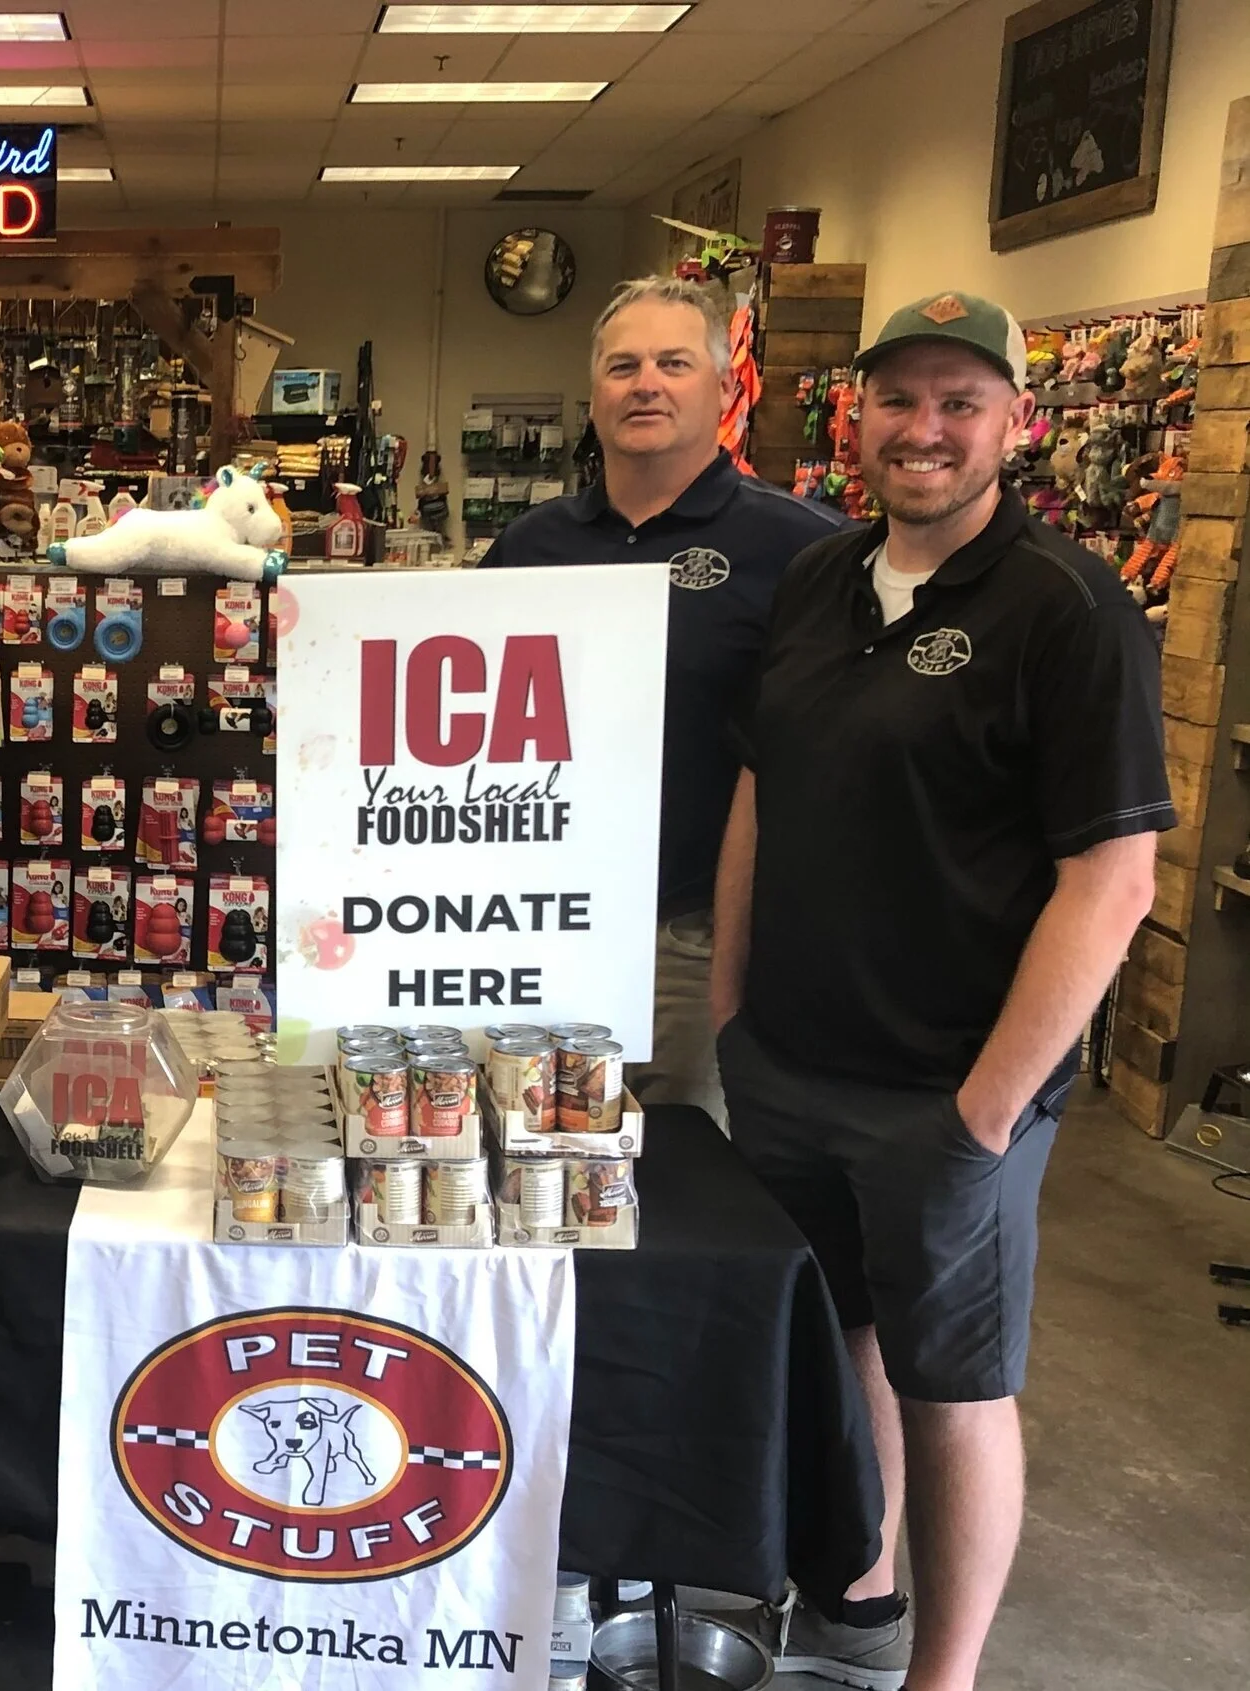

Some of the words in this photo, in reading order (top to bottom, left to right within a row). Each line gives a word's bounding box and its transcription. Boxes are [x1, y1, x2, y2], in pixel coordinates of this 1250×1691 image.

[224, 601, 245, 609] KONG
[156, 684, 178, 693] KONG
[223, 684, 245, 692] KONG
[359, 634, 572, 767] ICA
[362, 766, 448, 807] Your
[464, 762, 561, 804] Local
[357, 800, 571, 846] FOODSHELF
[86, 881, 108, 890] KONG
[222, 891, 248, 902] KONG
[342, 892, 591, 934] DONATE
[388, 967, 542, 1008] HERE
[52, 1072, 145, 1129] ICA
[50, 1138, 145, 1161] FOODSHELF
[223, 1331, 408, 1382] PET
[162, 1480, 447, 1561] STUFF
[80, 1598, 408, 1667] Minnetonka
[423, 1627, 523, 1673] MN
